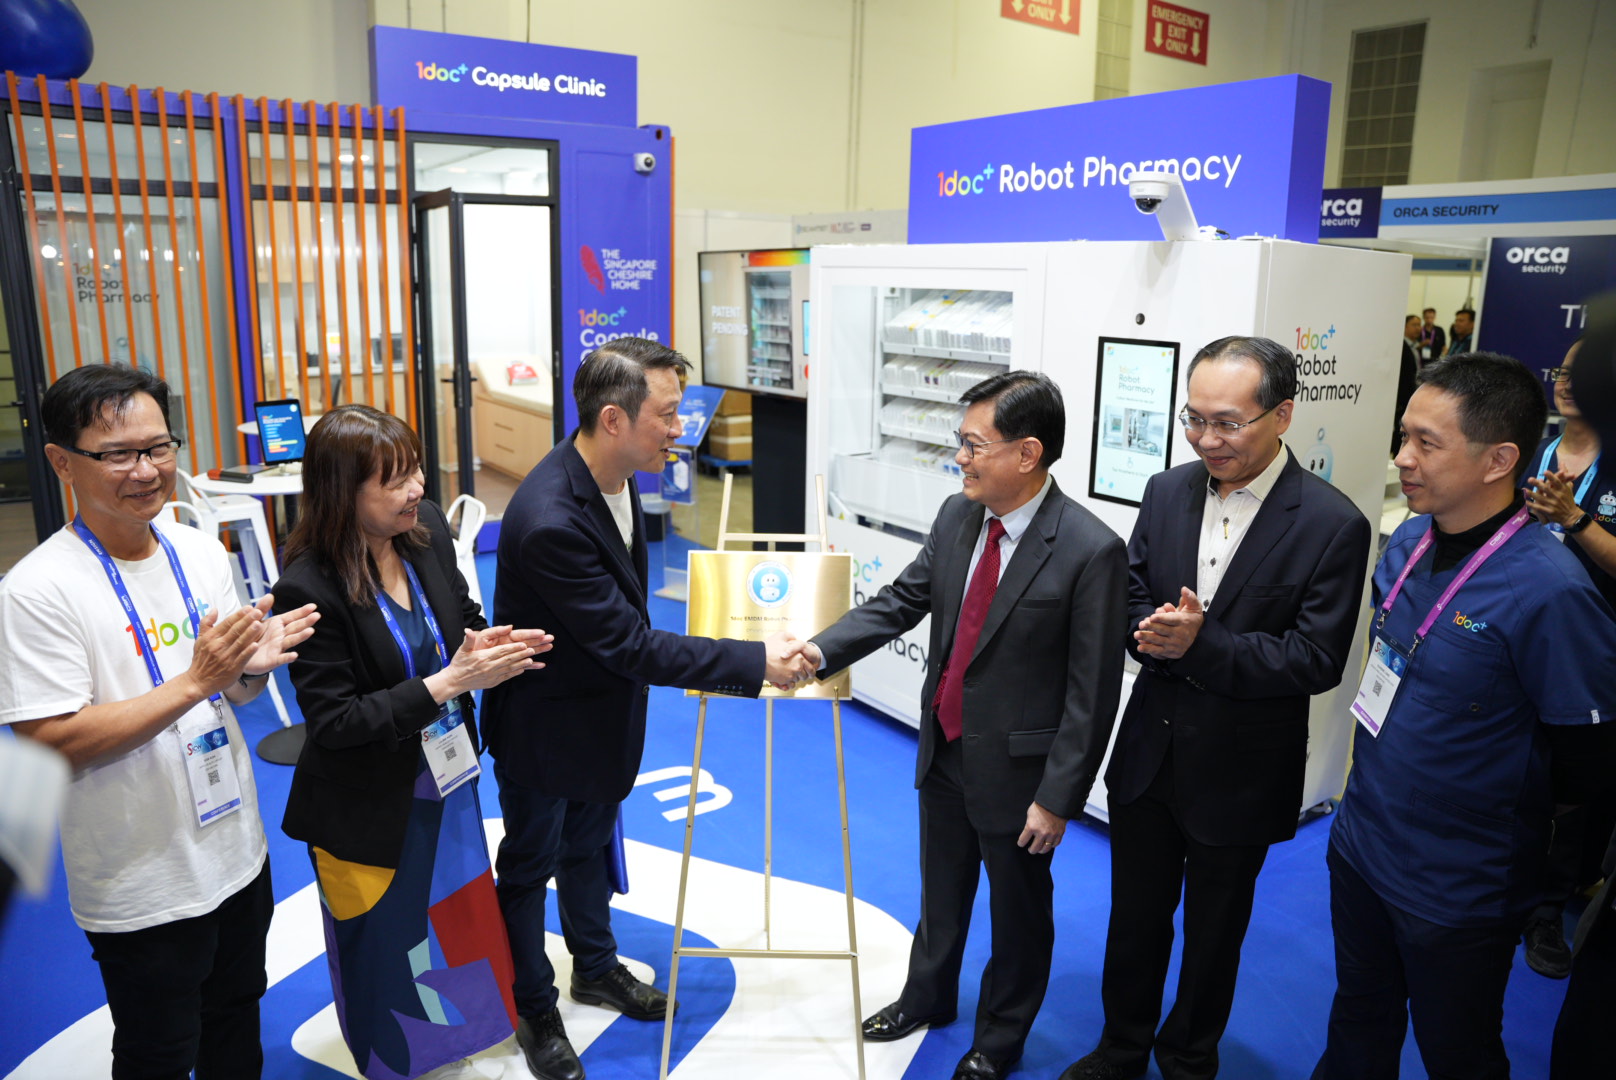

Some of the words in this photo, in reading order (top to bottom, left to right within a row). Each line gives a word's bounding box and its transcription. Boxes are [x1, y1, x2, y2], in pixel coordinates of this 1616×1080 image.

[1027, 3, 1056, 22] ONLY
[1152, 4, 1204, 30] EMERGENCY
[1168, 24, 1187, 40] EXIT
[1166, 38, 1188, 54] ONLY
[472, 66, 550, 92] Capsule
[554, 75, 606, 97] Clinic
[999, 161, 1074, 193] Robot
[1321, 197, 1363, 217] rca
[1393, 207, 1429, 218] ORCA
[1432, 204, 1500, 217] SECURITY
[1321, 217, 1361, 228] security
[601, 249, 620, 259] THE
[1506, 246, 1570, 264] orca
[604, 260, 658, 270] SINGAPORE
[1521, 263, 1566, 274] security
[608, 270, 653, 280] CHESHIRE
[611, 280, 640, 290] HOME
[79, 291, 160, 303] Pharac
[711, 305, 741, 318] PATENT
[712, 322, 748, 335] PENDING
[1295, 353, 1337, 376] Robot
[1119, 373, 1140, 384] Robot
[1118, 382, 1155, 396] Pharmacy
